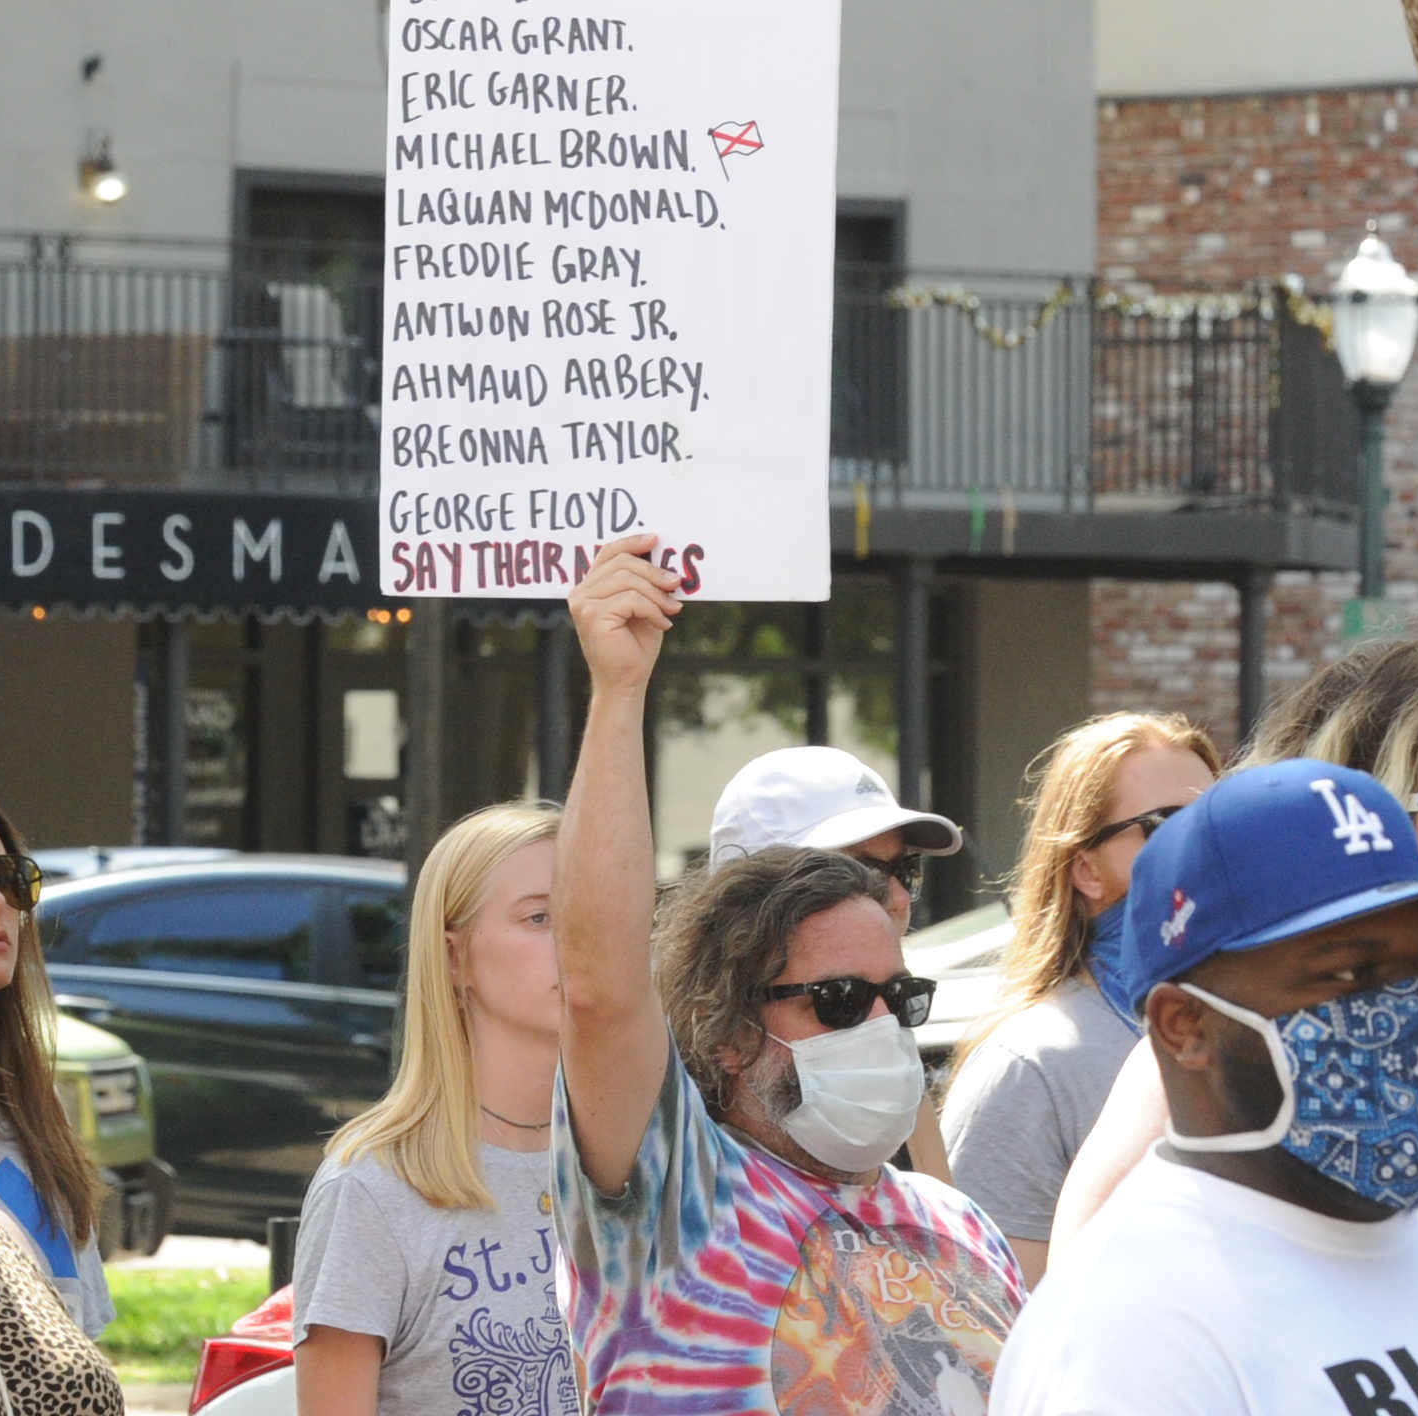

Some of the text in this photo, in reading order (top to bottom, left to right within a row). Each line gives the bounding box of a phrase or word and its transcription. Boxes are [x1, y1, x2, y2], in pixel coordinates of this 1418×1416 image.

[402, 16, 633, 55] OSCAR GRANT.
[402, 70, 637, 124] ERIC GARNER.
[396, 128, 696, 173] MICHAEL BROWN.
[398, 188, 725, 230] LAQUAN MCDONALD.
[394, 241, 647, 288] FREDDIE GRAY.
[393, 299, 677, 342] ANTWON ROSE JR.
[392, 354, 709, 412] AHMAUD ARBERY.
[392, 420, 693, 468] BREONNA TAYLOR.
[389, 487, 644, 540] GEORGE FLOYD.
[392, 539, 705, 594] SAY THEIR NES
[1310, 779, 1393, 856] LA
[438, 1237, 527, 1301] St.
